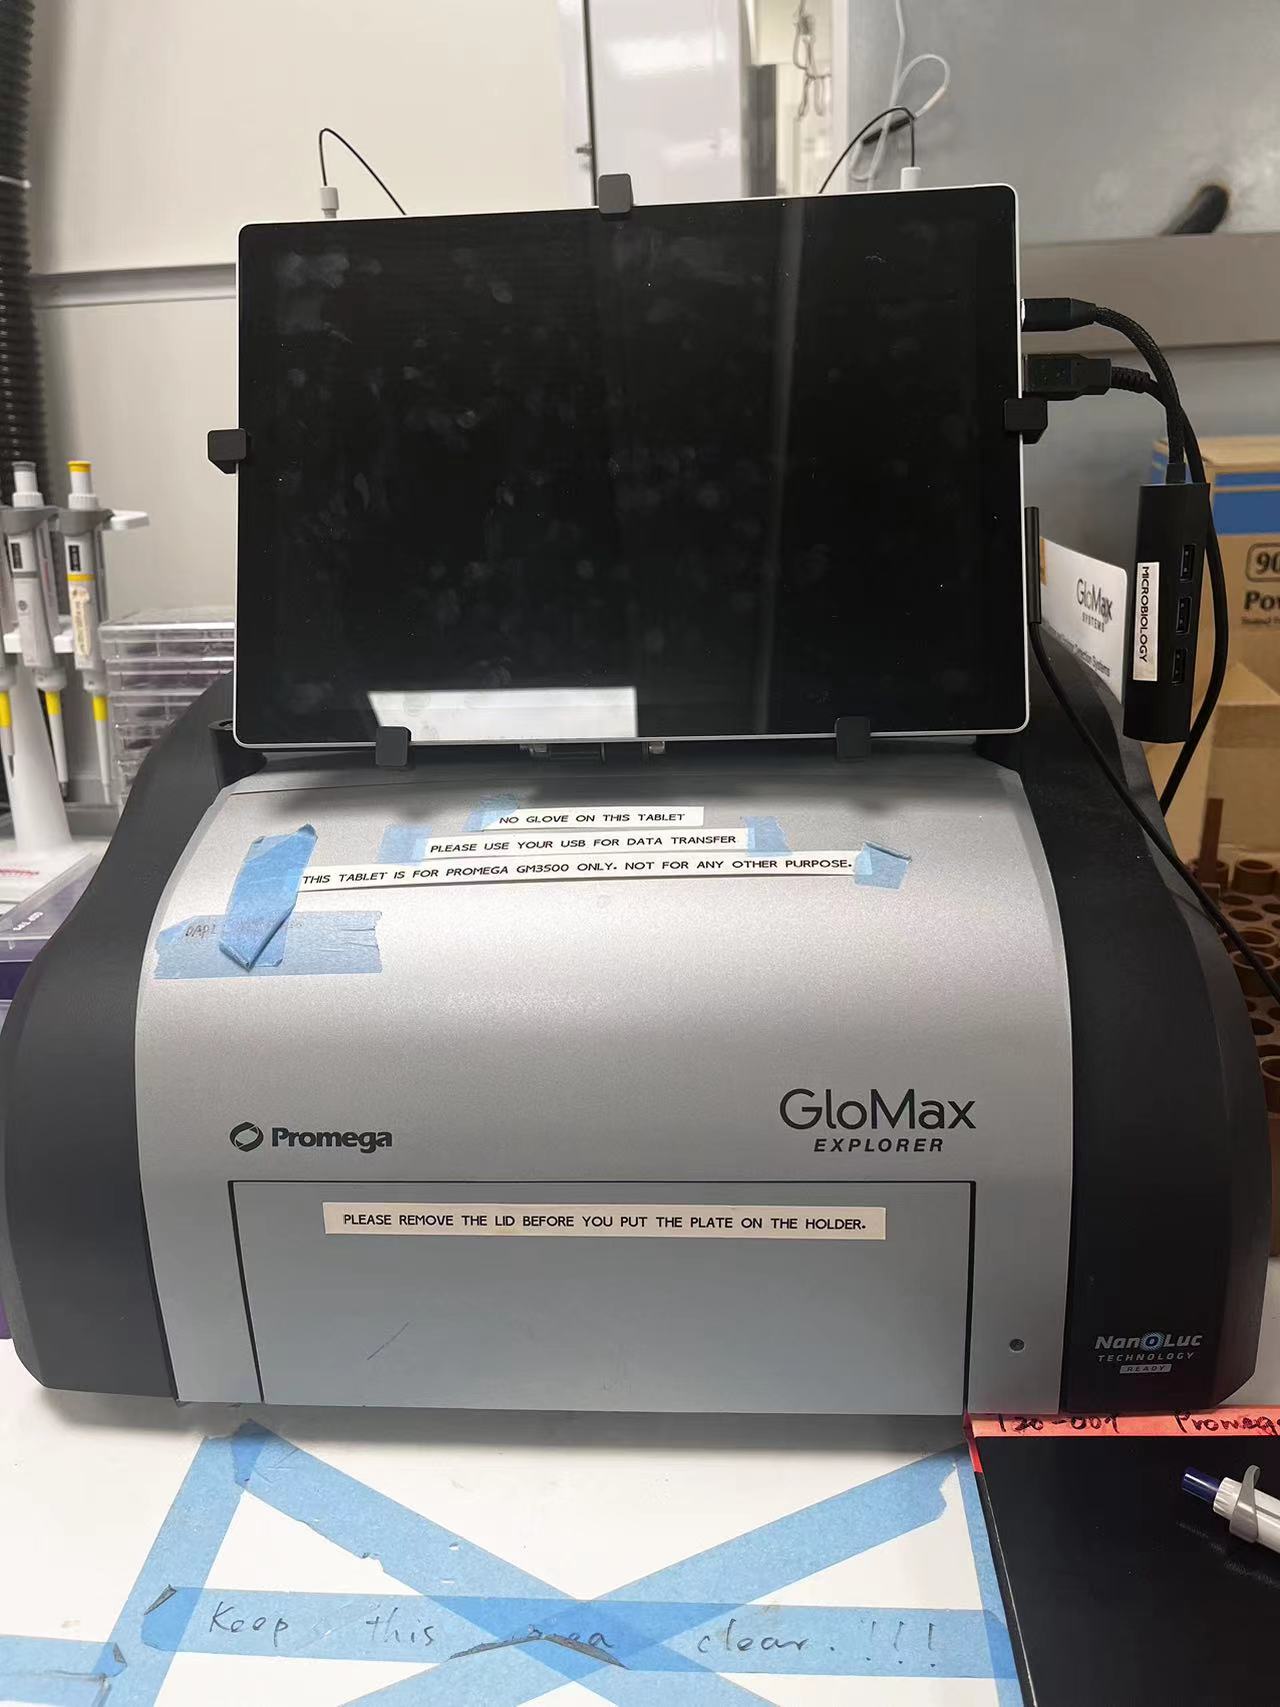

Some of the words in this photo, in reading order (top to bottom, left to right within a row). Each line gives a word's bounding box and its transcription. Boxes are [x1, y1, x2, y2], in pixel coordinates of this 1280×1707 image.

[1076, 578, 1113, 621] GloMax
[1082, 612, 1105, 633] SYSTEMS
[1139, 566, 1150, 663] MICROBIOLOGY
[499, 815, 519, 824] NO
[526, 814, 569, 824] GLOVE
[575, 813, 595, 823] ON
[602, 813, 631, 822] THIS
[638, 812, 686, 822] TABLET
[430, 843, 478, 853] PLEASE
[484, 841, 510, 851] USE
[517, 840, 554, 850] YOUR
[560, 839, 586, 848] USB
[593, 838, 620, 847] FOR
[626, 836, 663, 846] DATA
[670, 835, 737, 845] TRANSFER
[302, 874, 331, 885] THIS
[338, 871, 388, 882] TABLET
[393, 871, 405, 880] IS
[412, 869, 439, 879] FOR
[446, 866, 509, 877] PROMEGA
[516, 863, 570, 874] GM3500
[577, 862, 618, 872] ONLY.
[624, 861, 655, 871] NOT
[661, 860, 690, 870] FOR
[696, 860, 724, 869] ANY
[732, 859, 778, 869] OTHER
[785, 859, 853, 869] PURPOSE.
[779, 1088, 977, 1130] GloMax
[272, 1127, 393, 1154] Promega
[813, 1138, 944, 1152] EXPLORER
[343, 1214, 392, 1225] PLEASE
[399, 1214, 454, 1226] REMOVE
[461, 1215, 488, 1226] THE
[495, 1215, 516, 1226] LID
[522, 1215, 575, 1227] BEFORE
[581, 1216, 613, 1227] YOU
[620, 1216, 648, 1228] PUT
[656, 1216, 683, 1228] THE
[690, 1217, 733, 1229] PLATE
[741, 1217, 763, 1229] ON
[771, 1218, 798, 1229] THE
[805, 1218, 866, 1230] HOLDER.
[1098, 1352, 1195, 1362] TECHNOLOGY
[1127, 1365, 1166, 1373] READY
[208, 1601, 289, 1647] Keep
[366, 1607, 438, 1647] this
